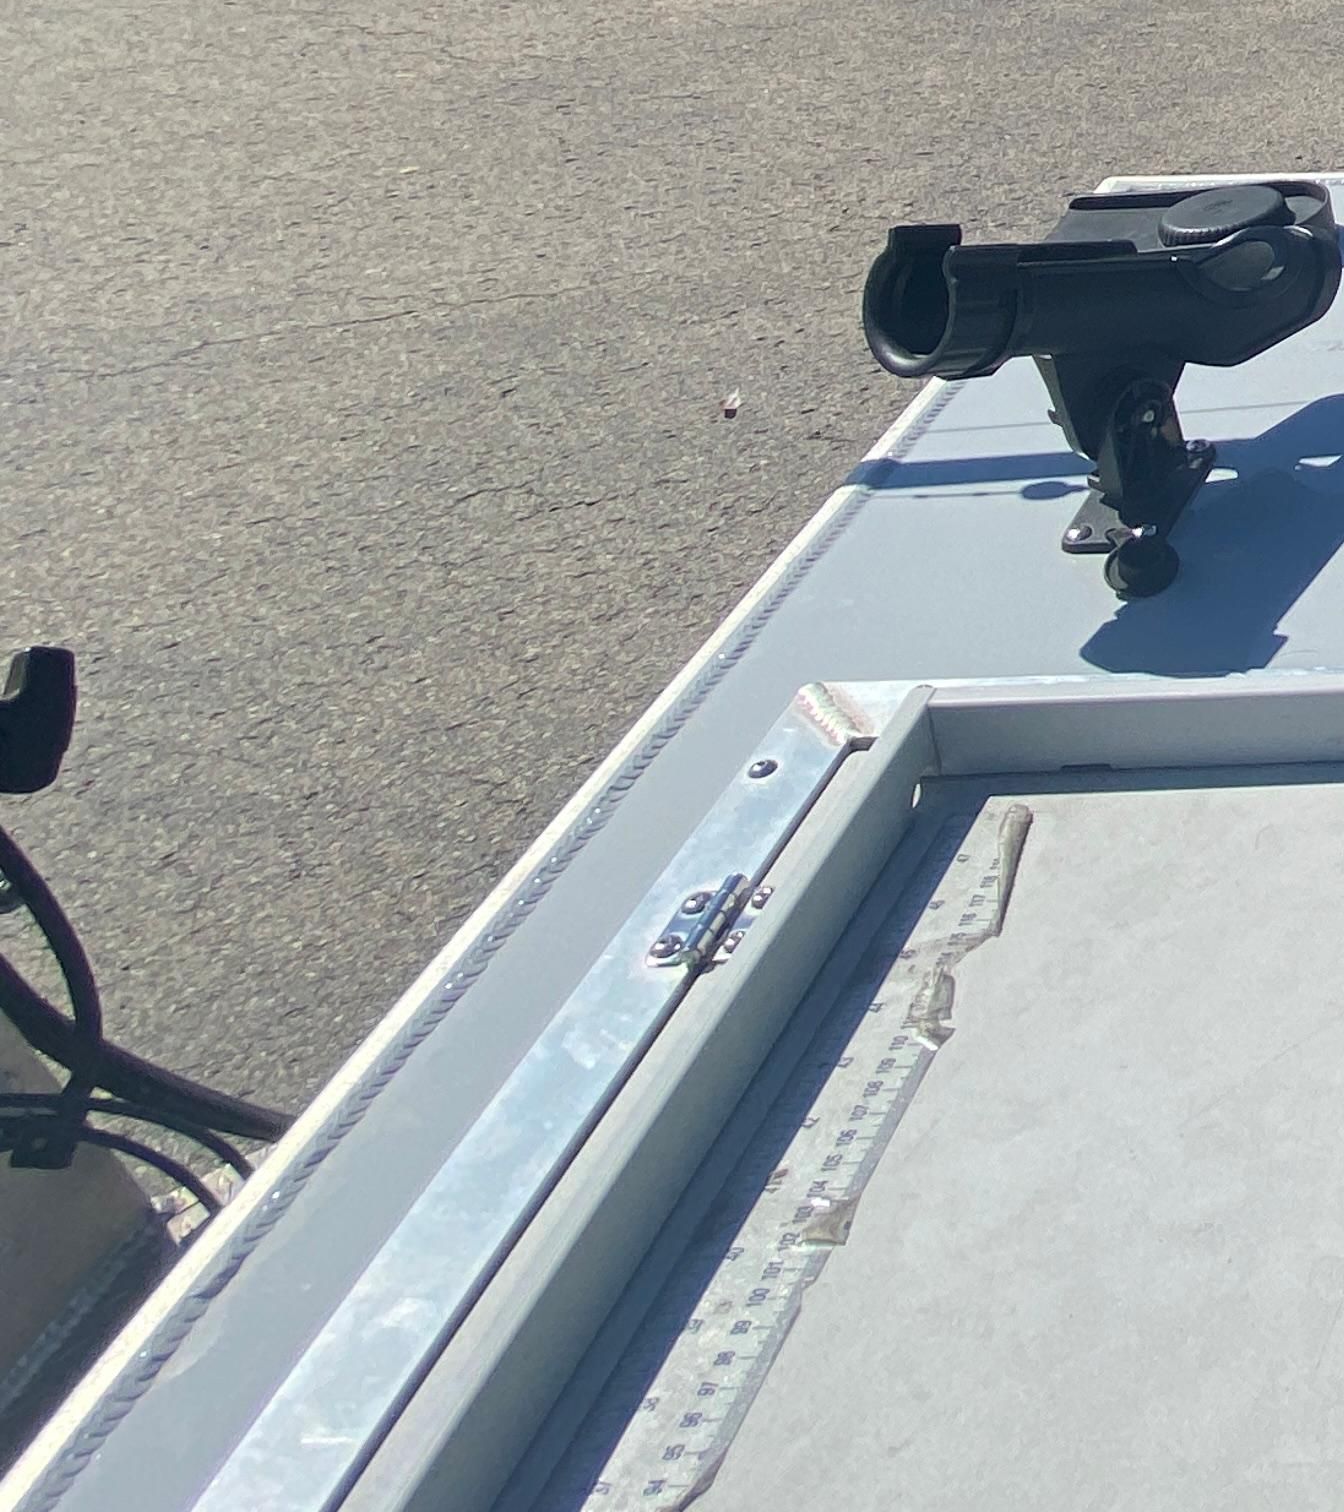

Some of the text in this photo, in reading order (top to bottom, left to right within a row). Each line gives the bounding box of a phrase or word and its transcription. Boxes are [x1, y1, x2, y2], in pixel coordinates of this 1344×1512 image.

[662, 1444, 685, 1461] 95
[679, 1412, 702, 1428] 96
[697, 1382, 719, 1396] 97
[713, 1351, 735, 1366] 98
[730, 1320, 752, 1335] 99
[745, 1288, 770, 1307] 100
[761, 1261, 784, 1281] 101
[778, 1232, 801, 1251] 102
[792, 1205, 814, 1224] 103
[807, 1180, 828, 1197] 104
[821, 1154, 843, 1172] 105
[836, 1129, 857, 1147] 106
[849, 1105, 870, 1121] 107
[863, 1080, 884, 1098] 108
[876, 1058, 896, 1074] 109
[888, 1035, 909, 1051] 110
[958, 913, 977, 926] 116
[969, 894, 986, 906] 117
[727, 1247, 744, 1261] 40
